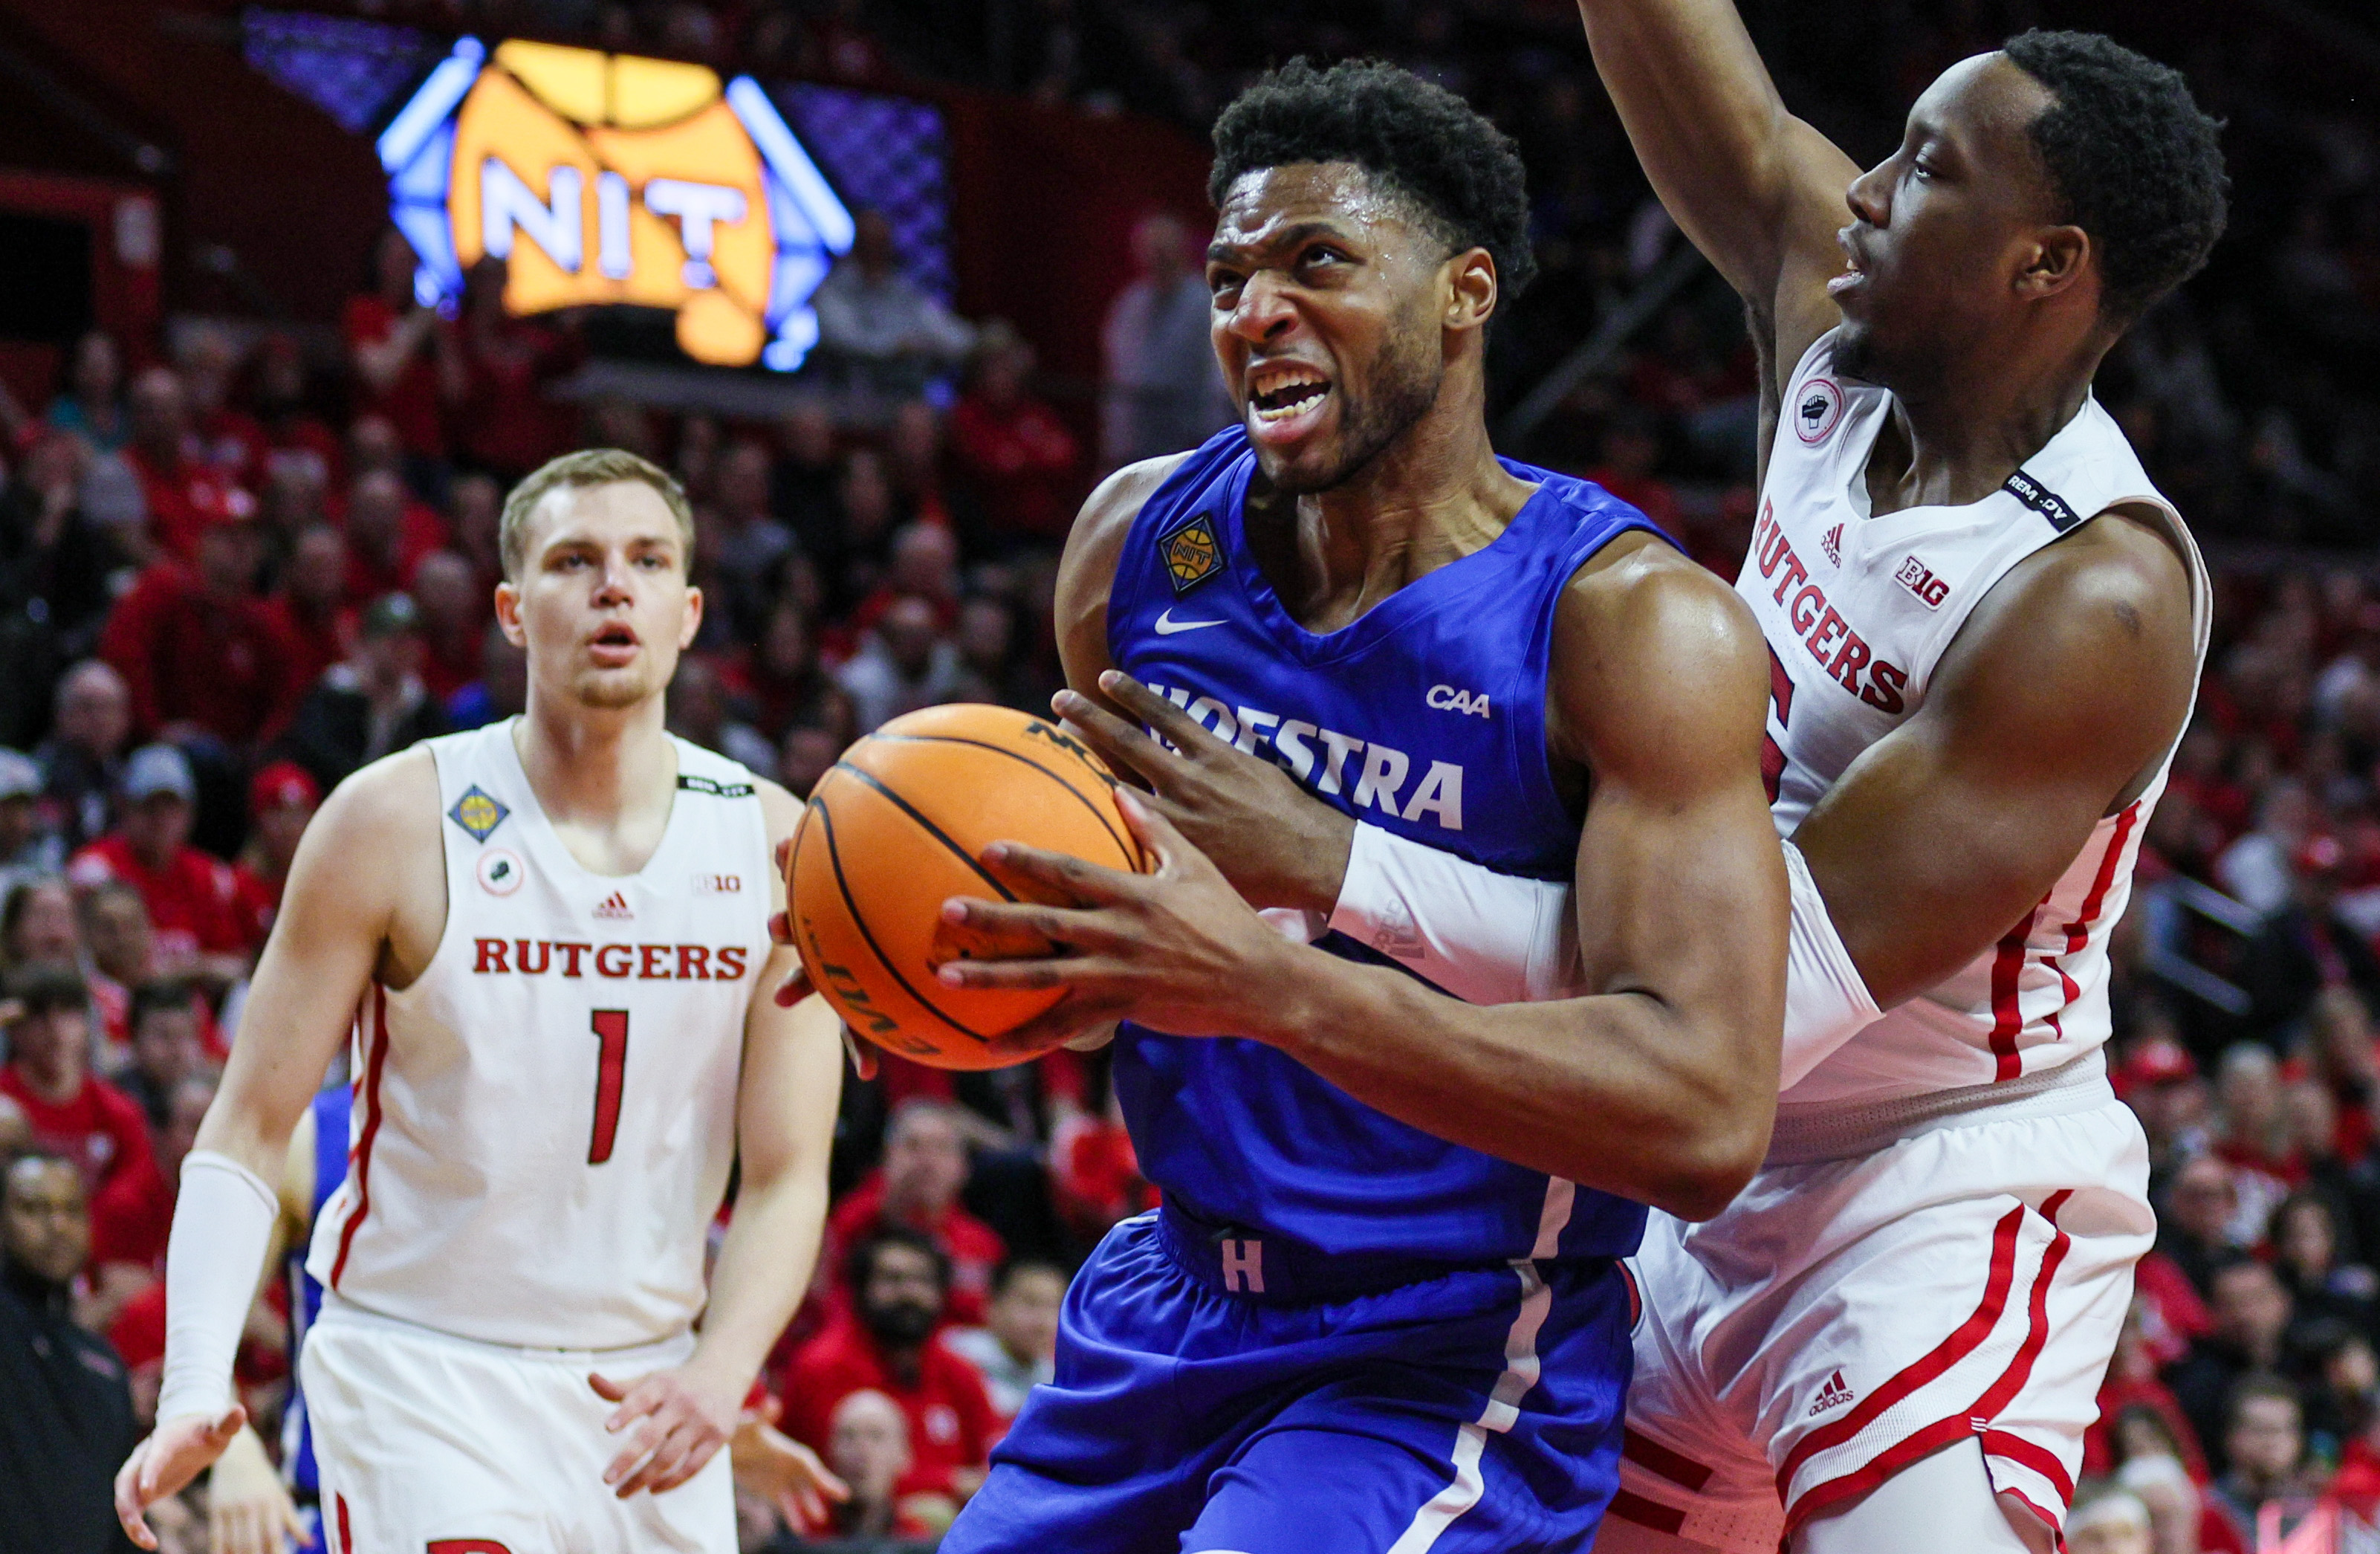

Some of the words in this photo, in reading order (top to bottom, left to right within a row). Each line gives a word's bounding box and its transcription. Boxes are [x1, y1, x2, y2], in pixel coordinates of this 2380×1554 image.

[481, 156, 748, 288] NIT
[1174, 543, 1211, 565] NIT
[1754, 493, 1908, 715] RUTGERS
[1426, 684, 1490, 719] CAA
[473, 938, 747, 981] RUTGERS
[587, 1008, 629, 1165] 1
[1222, 1239, 1265, 1292] H
[1809, 1390, 1854, 1417] adidas
